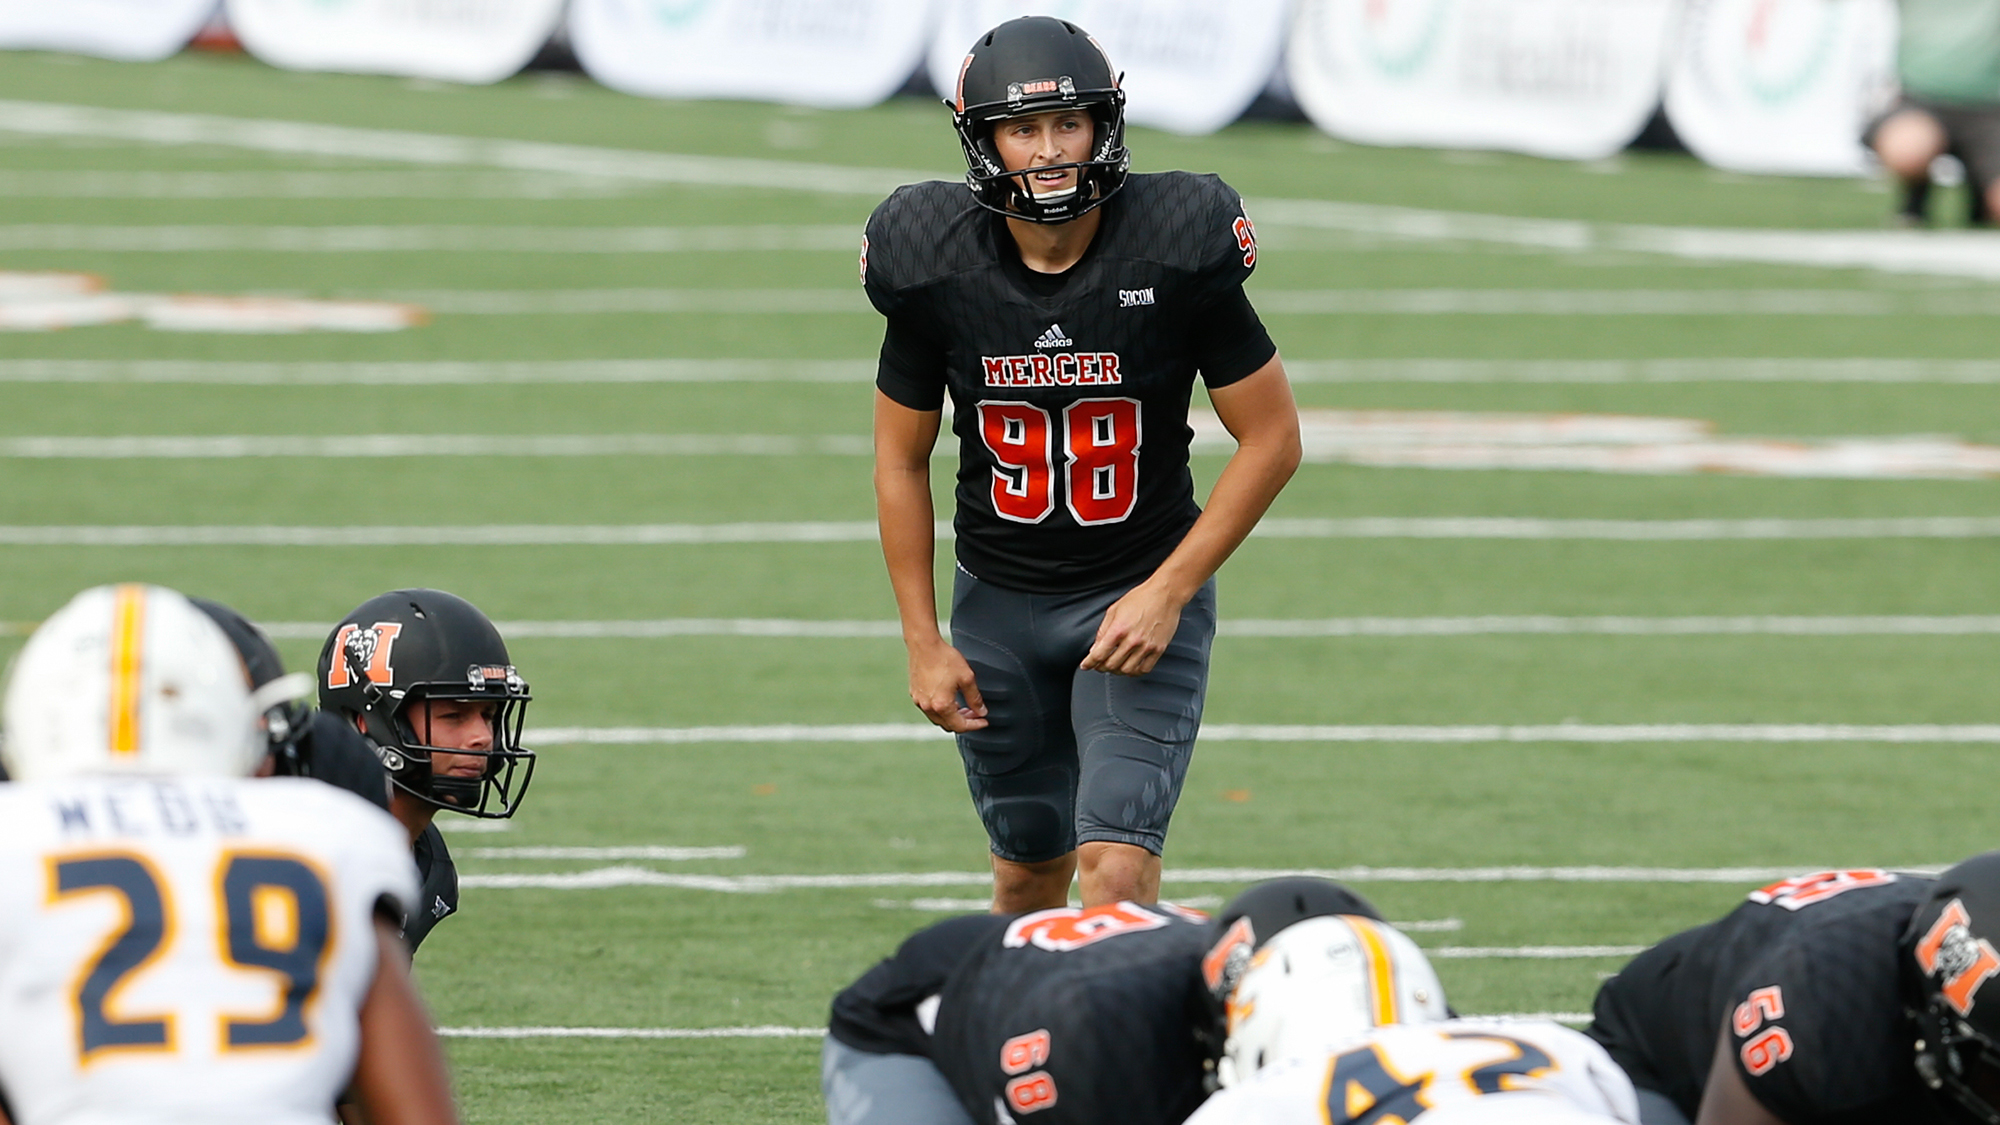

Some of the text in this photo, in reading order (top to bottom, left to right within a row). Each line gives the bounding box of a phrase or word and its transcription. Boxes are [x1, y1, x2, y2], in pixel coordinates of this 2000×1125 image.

[1119, 287, 1155, 307] SOCON
[981, 352, 1122, 387] MERCER
[1034, 337, 1073, 349] adidas
[975, 397, 1143, 526] 98
[42, 849, 334, 1068] 29
[1000, 1028, 1058, 1115] 68
[1733, 985, 1794, 1077] 56
[1318, 1031, 1561, 1125] 42
